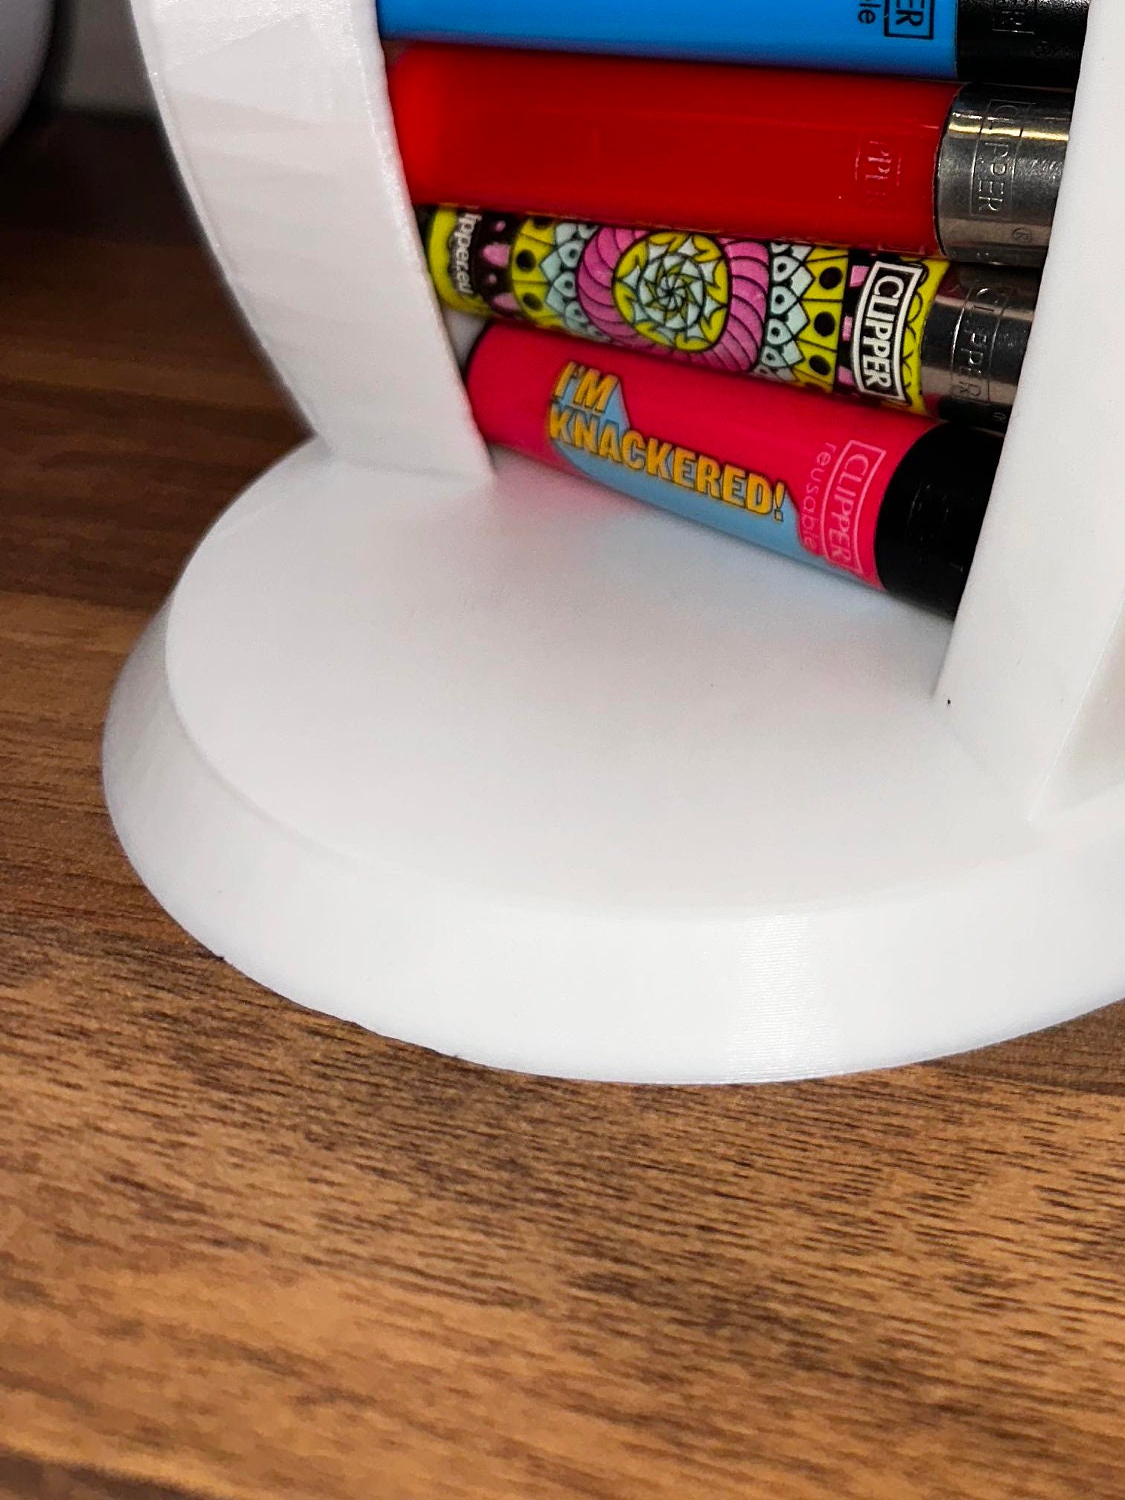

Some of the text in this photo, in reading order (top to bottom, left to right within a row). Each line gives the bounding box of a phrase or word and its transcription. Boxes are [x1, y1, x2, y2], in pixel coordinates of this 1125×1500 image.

[862, 275, 905, 388] CLIPPER
[553, 361, 620, 415] I'M
[549, 402, 787, 522] KNACKERED!
[802, 442, 837, 550] reusable
[828, 453, 869, 561] CLIPPER
